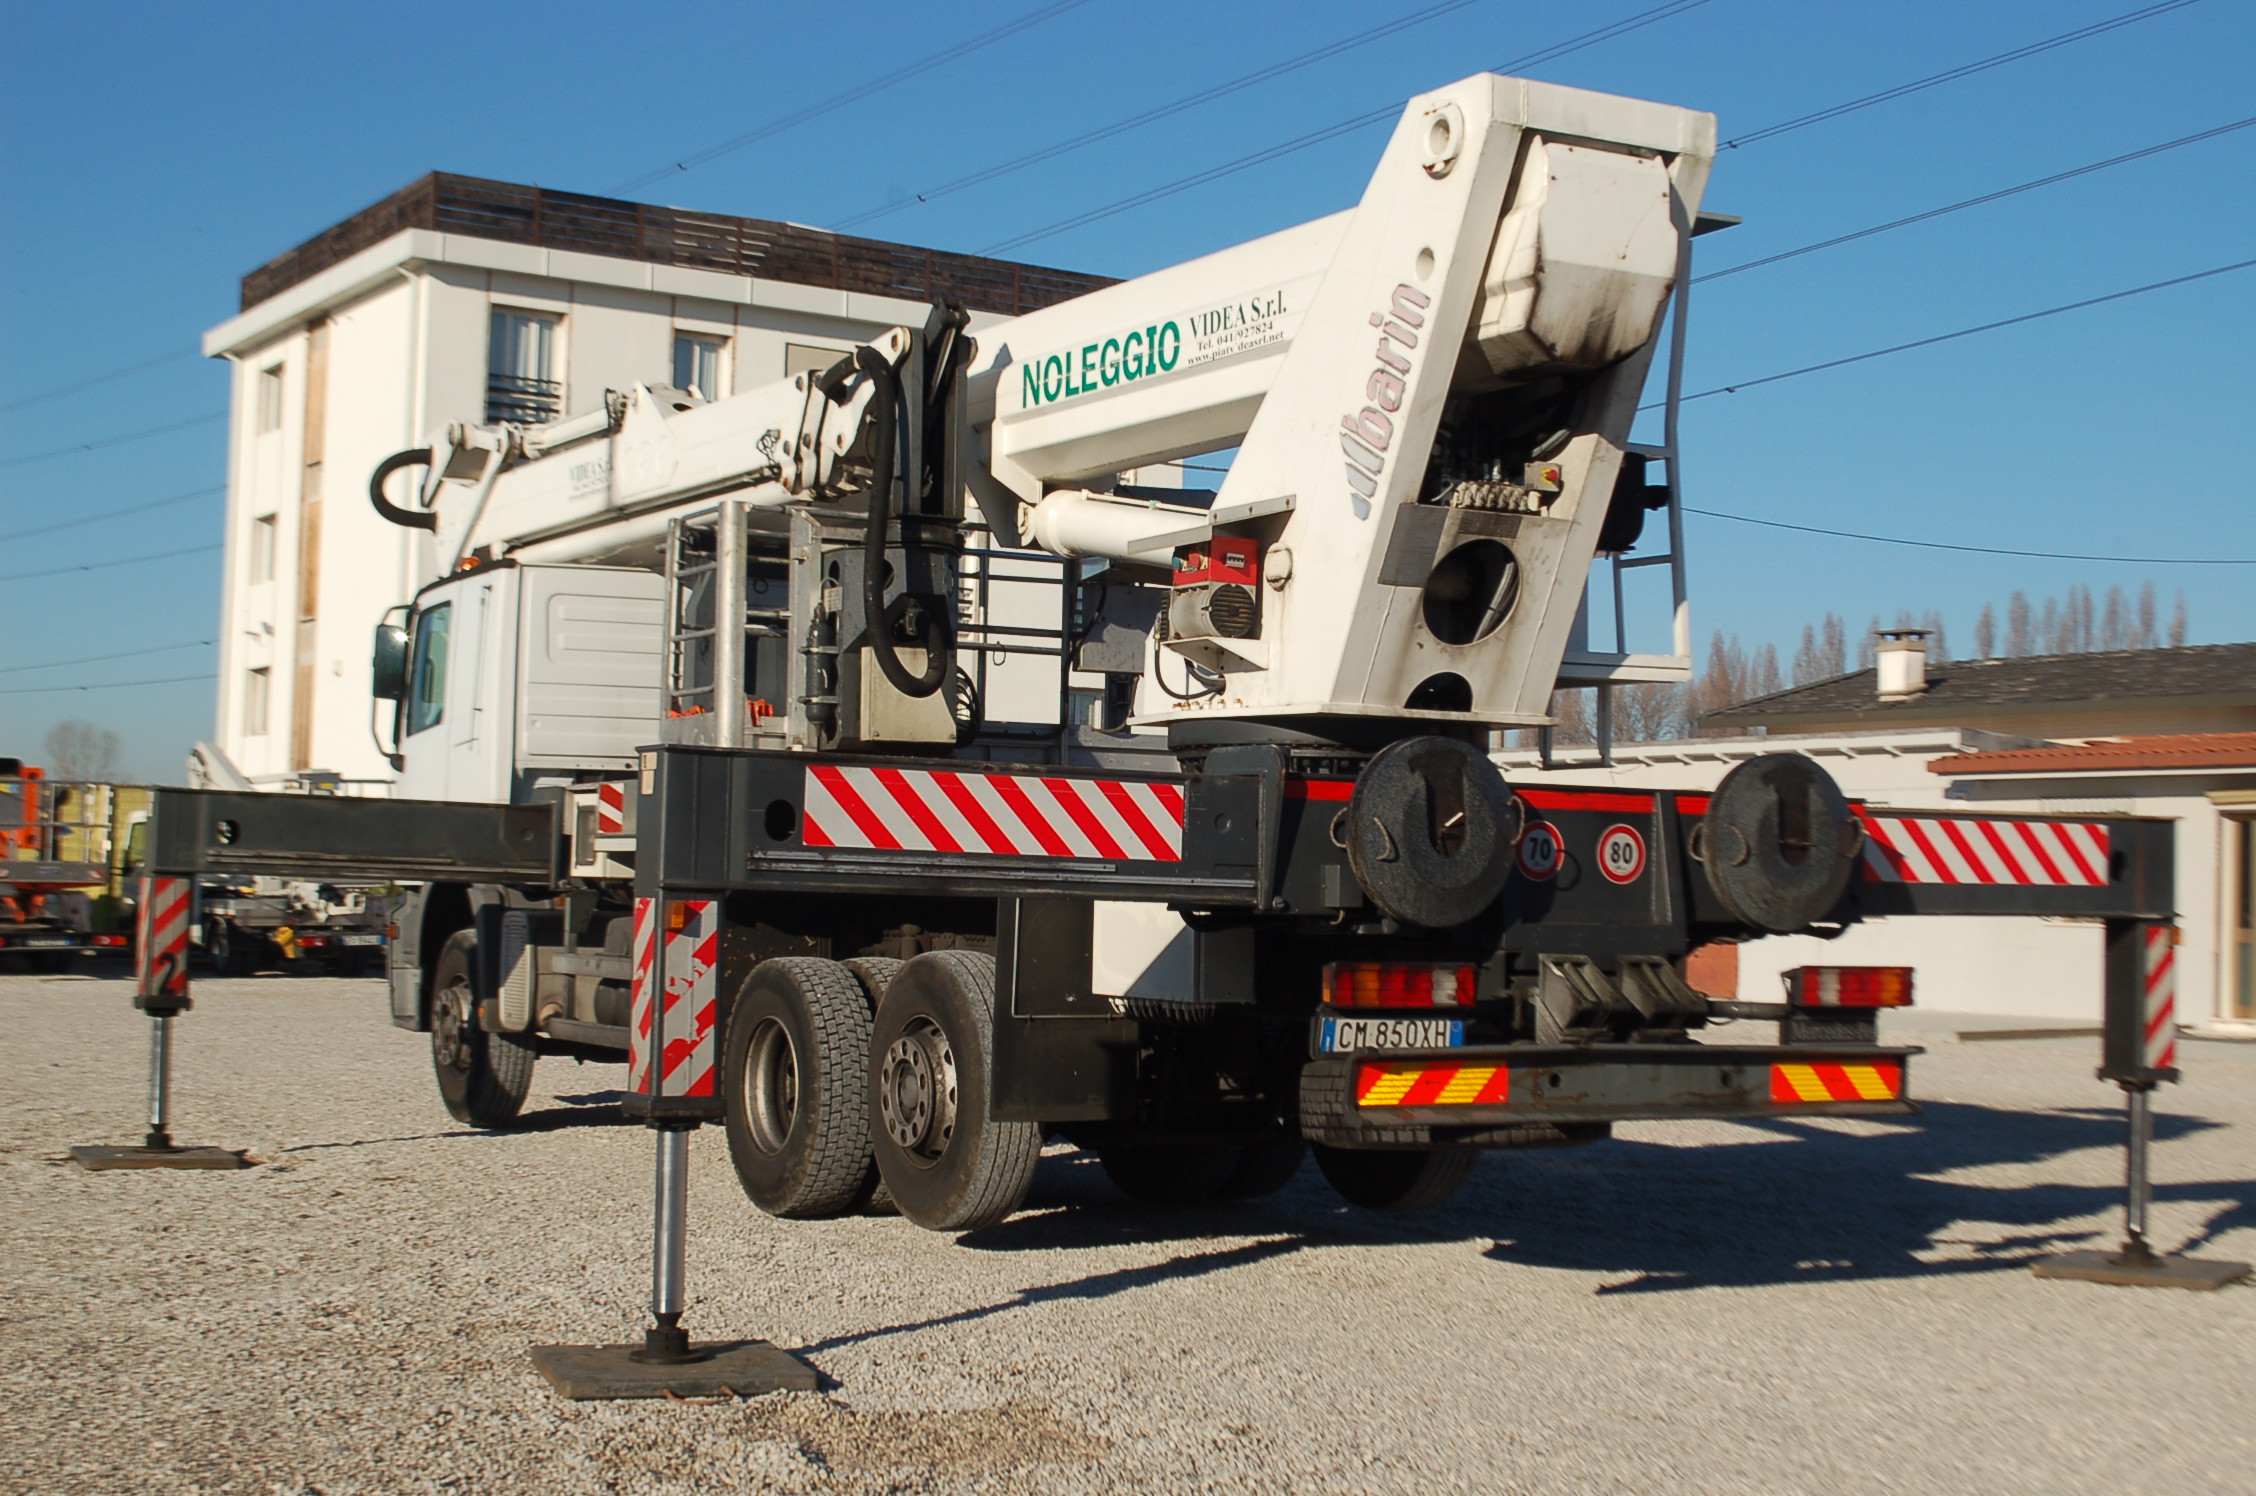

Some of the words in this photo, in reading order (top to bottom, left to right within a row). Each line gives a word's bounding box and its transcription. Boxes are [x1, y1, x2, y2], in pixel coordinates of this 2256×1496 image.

[1189, 302, 1246, 339] VIDEA
[1250, 290, 1287, 322] S.r.l.
[1197, 339, 1214, 352] Tel.
[1216, 321, 1273, 344] 041/927824
[1022, 321, 1181, 408] NOLEGGIO
[1528, 837, 1550, 861] 70
[1611, 841, 1633, 864] 80
[158, 952, 176, 996] 2
[1339, 1022, 1368, 1048] CM
[1375, 1020, 1447, 1048] 850XH
